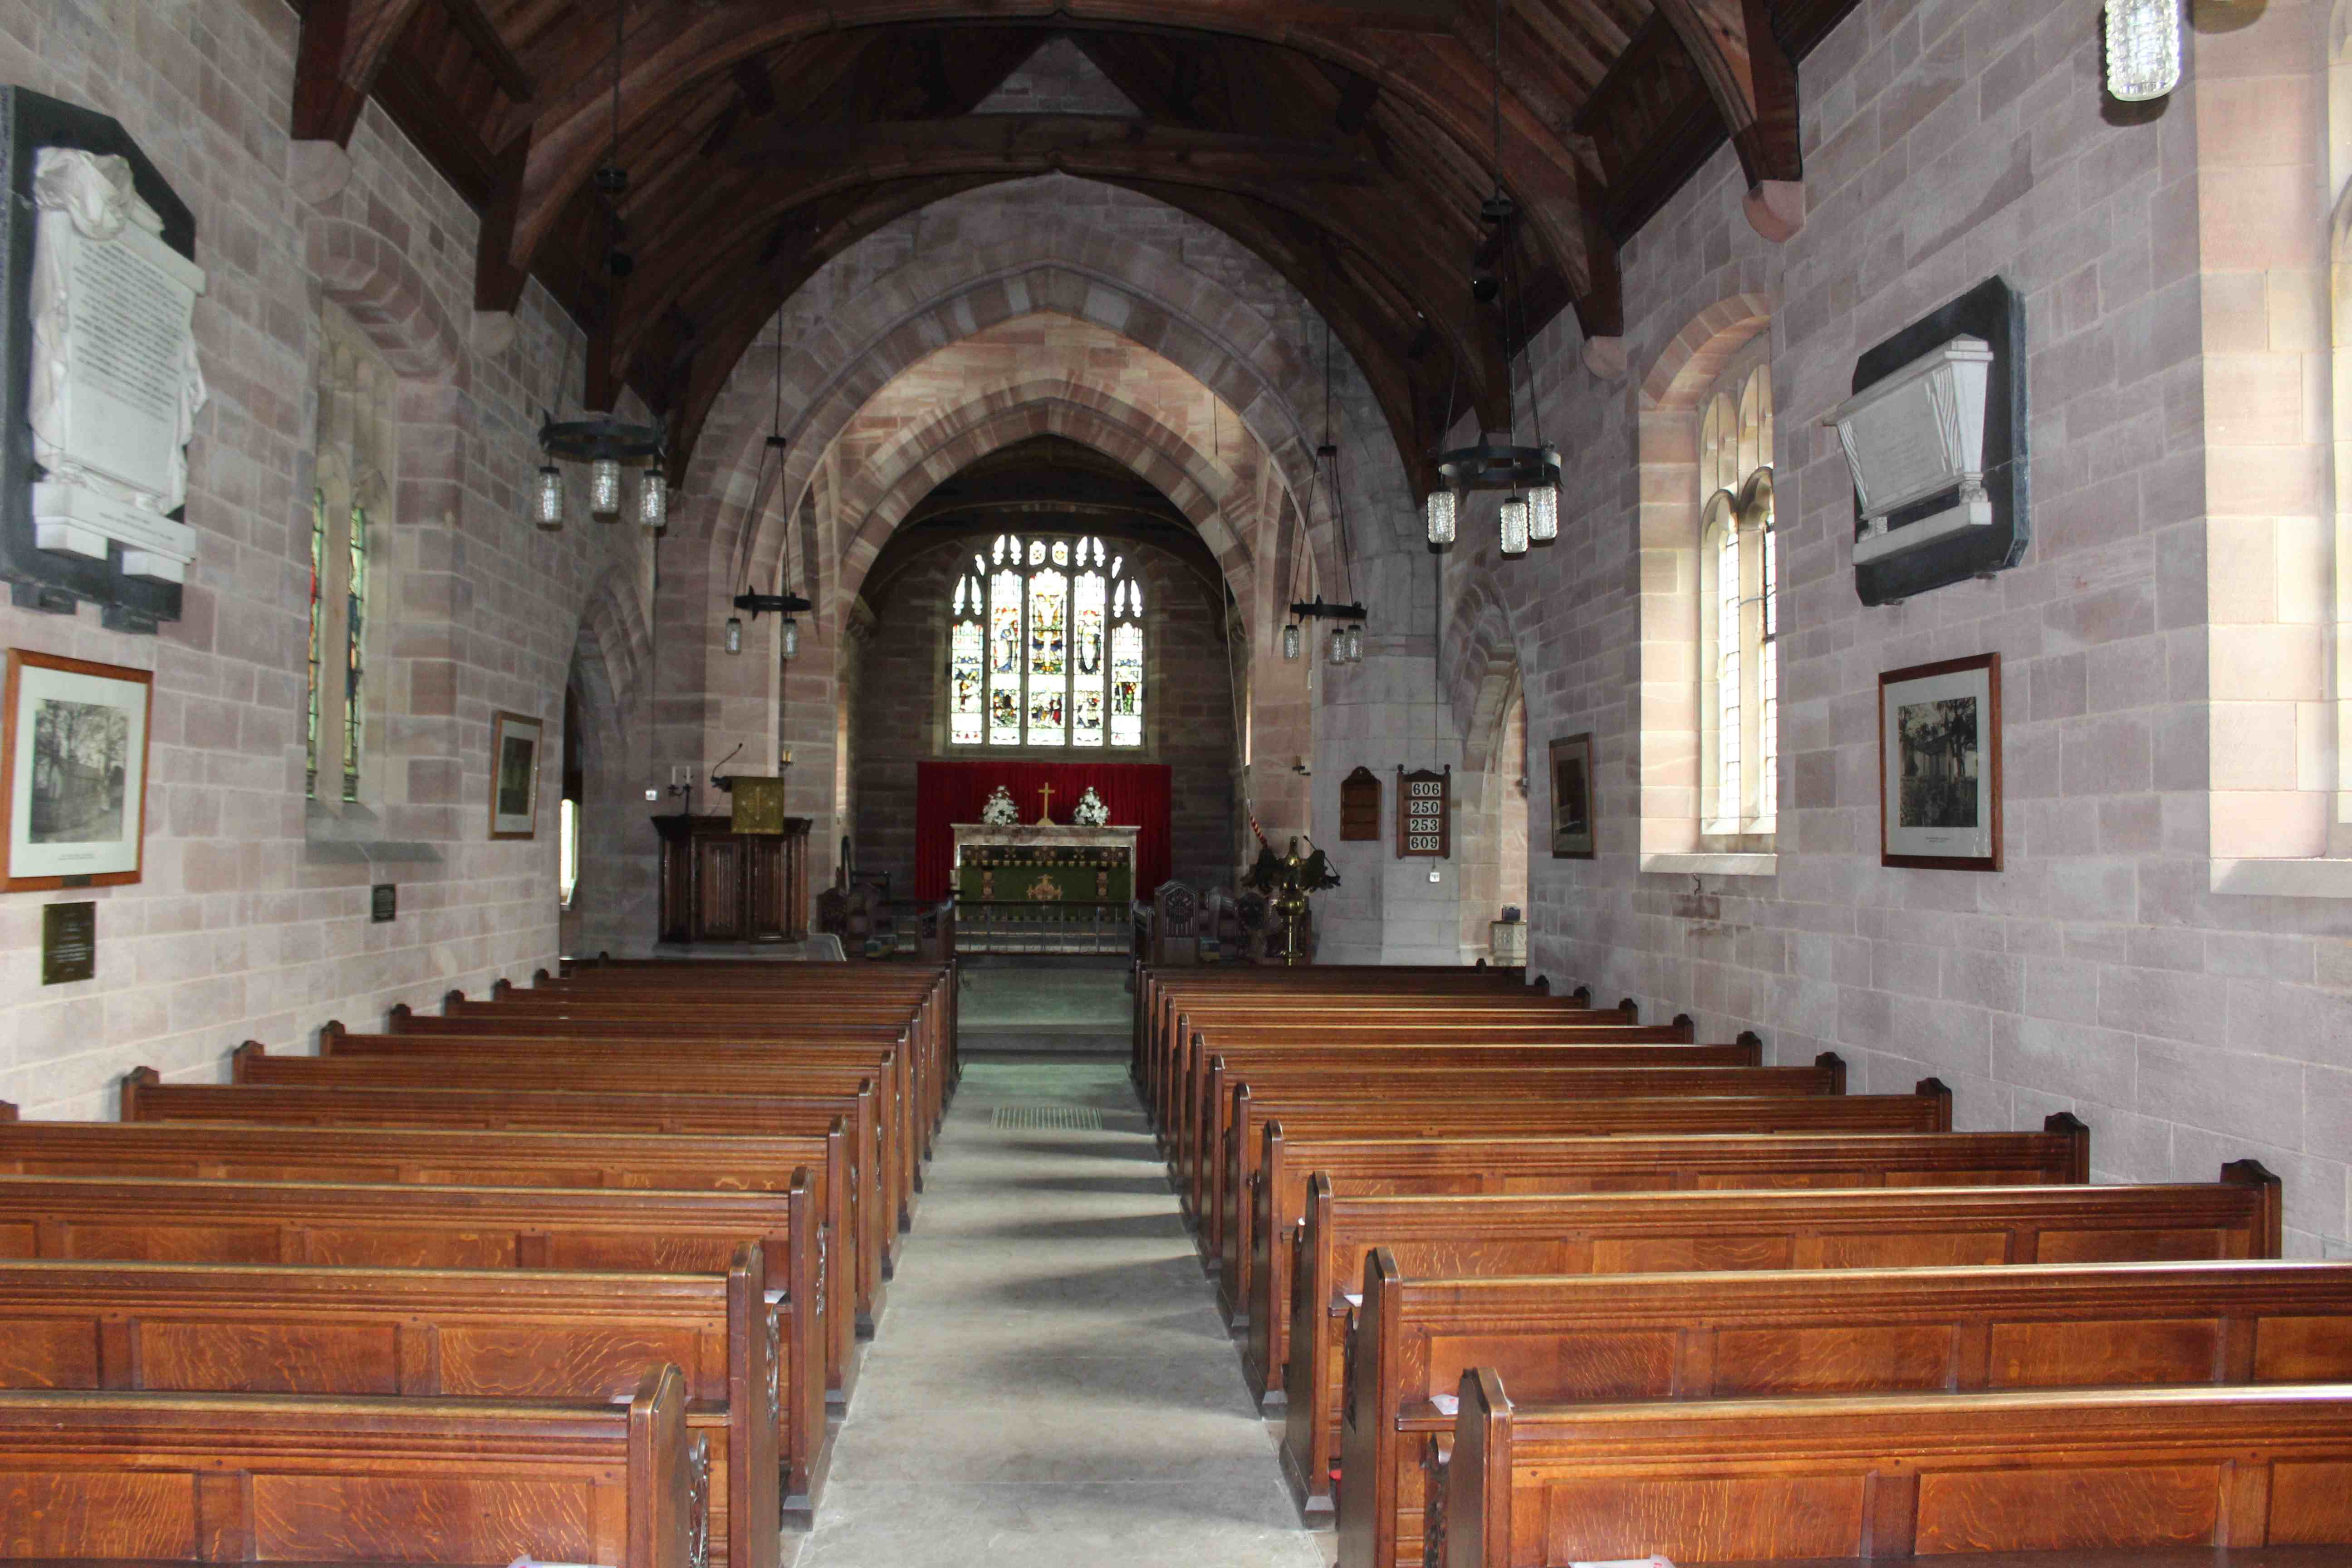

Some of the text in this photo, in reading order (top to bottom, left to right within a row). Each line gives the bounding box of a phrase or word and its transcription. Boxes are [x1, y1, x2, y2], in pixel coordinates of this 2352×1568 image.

[1413, 783, 1439, 795] 606
[1412, 801, 1438, 813] 250
[1411, 819, 1437, 831] 253
[1411, 837, 1437, 848] 609
